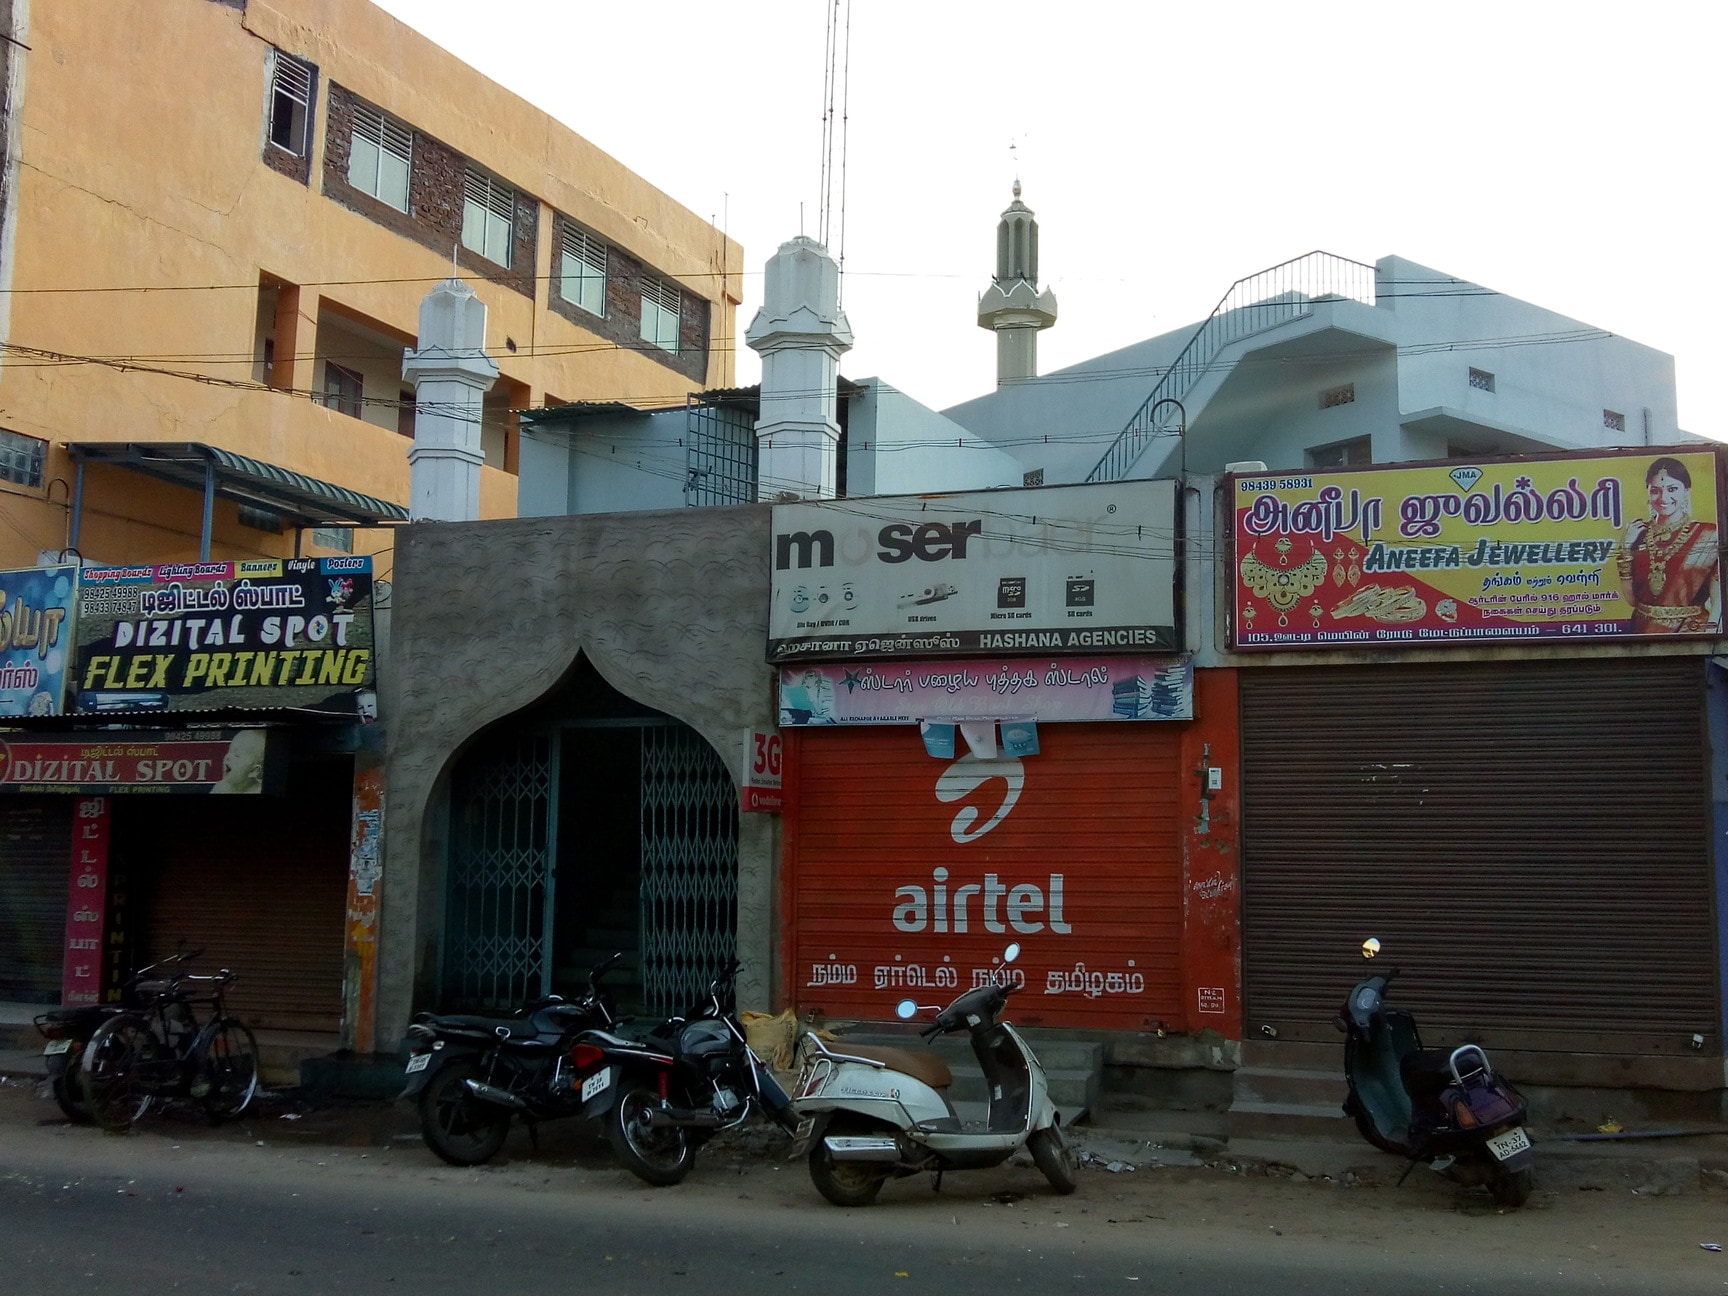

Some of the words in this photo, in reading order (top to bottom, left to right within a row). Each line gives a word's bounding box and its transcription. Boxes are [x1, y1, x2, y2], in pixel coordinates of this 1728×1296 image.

[1456, 470, 1477, 480] JMA
[1241, 479, 1277, 491] 98439
[1279, 478, 1313, 489] 58931
[1245, 486, 1383, 542] அனீபா
[327, 558, 364, 569] Posters
[1366, 541, 1461, 571] ANEEFA
[1467, 538, 1614, 568] JEWELLERY
[84, 568, 120, 582] Shopping
[121, 567, 152, 579] Boards
[159, 564, 194, 580] Lighting
[194, 563, 227, 575] Boards
[240, 562, 278, 572] Banners
[1482, 571, 1522, 591] தங்கம்
[1556, 568, 1602, 586] வெள்ளி
[84, 588, 110, 600] 98425
[112, 587, 138, 599] 49988
[234, 579, 305, 610] ஸ்பாட்
[1509, 593, 1538, 604] பேரில்
[1541, 593, 1559, 602] 916
[84, 602, 110, 614] 98433
[112, 601, 137, 613] 74847
[1482, 606, 1523, 618] நகைகள்
[1525, 604, 1557, 617] செய்து
[115, 614, 245, 650] DIZITAL
[260, 614, 355, 648] SPOT
[1561, 623, 1588, 634] 641
[979, 632, 1063, 648] HASHANA
[1067, 630, 1157, 647] AGENCIES
[83, 653, 176, 689] FLEX
[182, 649, 370, 688] PRINTING
[986, 666, 1038, 694] புத்தக
[753, 732, 782, 776] 3G
[135, 759, 212, 781] SPOT
[892, 866, 1072, 934] airtel
[807, 953, 857, 987] நம்ம
[873, 954, 958, 990] ஏர்டெல்
[1044, 959, 1145, 999] தமிழகம்
